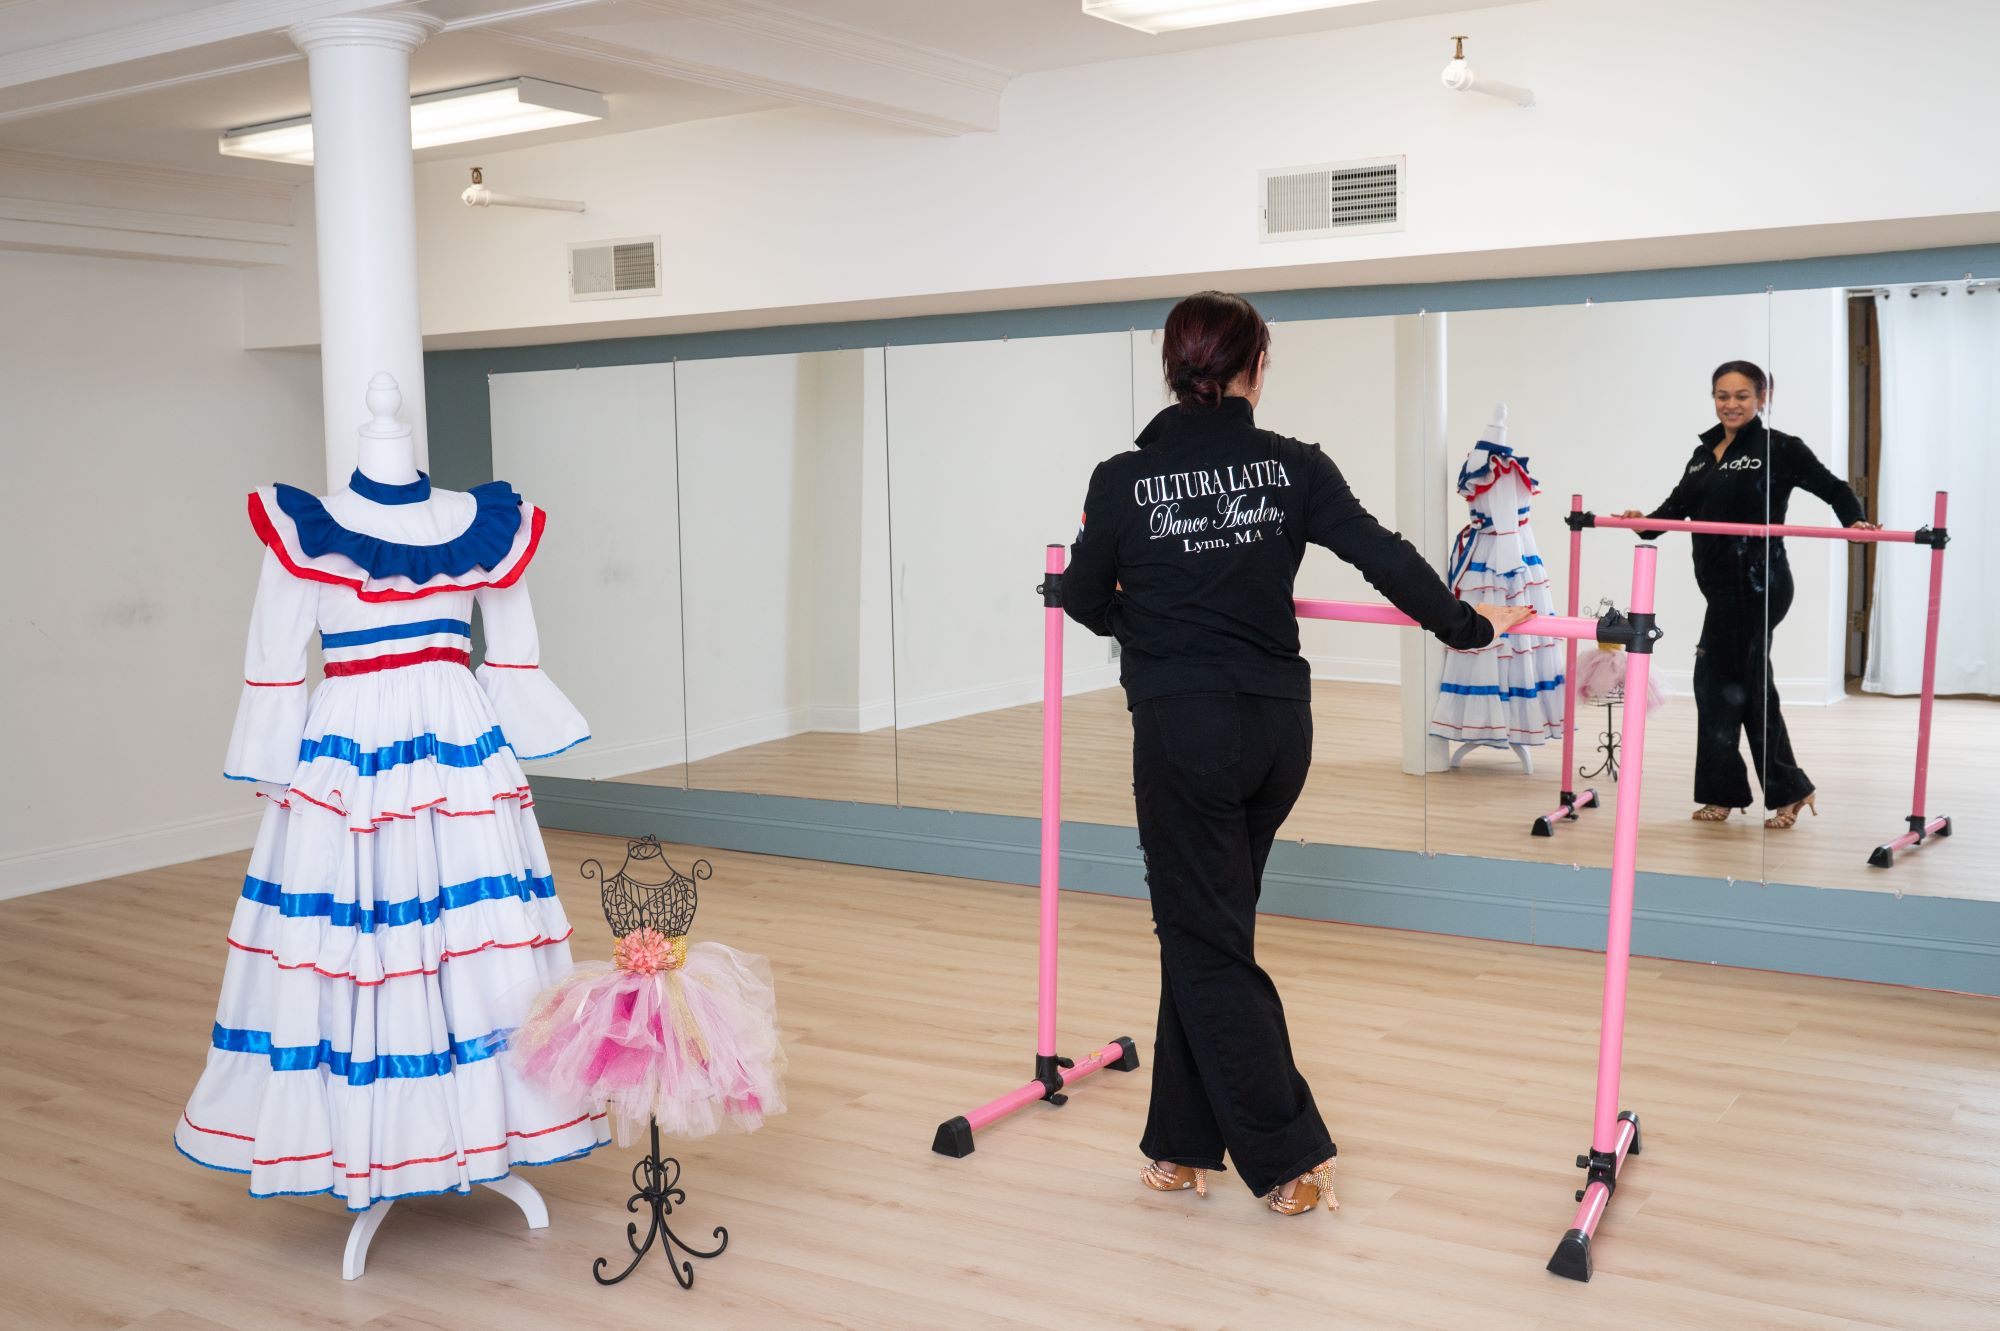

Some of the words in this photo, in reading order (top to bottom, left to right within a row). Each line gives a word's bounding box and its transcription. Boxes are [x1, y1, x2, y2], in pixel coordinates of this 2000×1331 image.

[1134, 468, 1226, 506] CULTURA
[1149, 503, 1208, 540] Dance
[1183, 539, 1230, 554] Lynn,
[1235, 529, 1264, 545] MA
